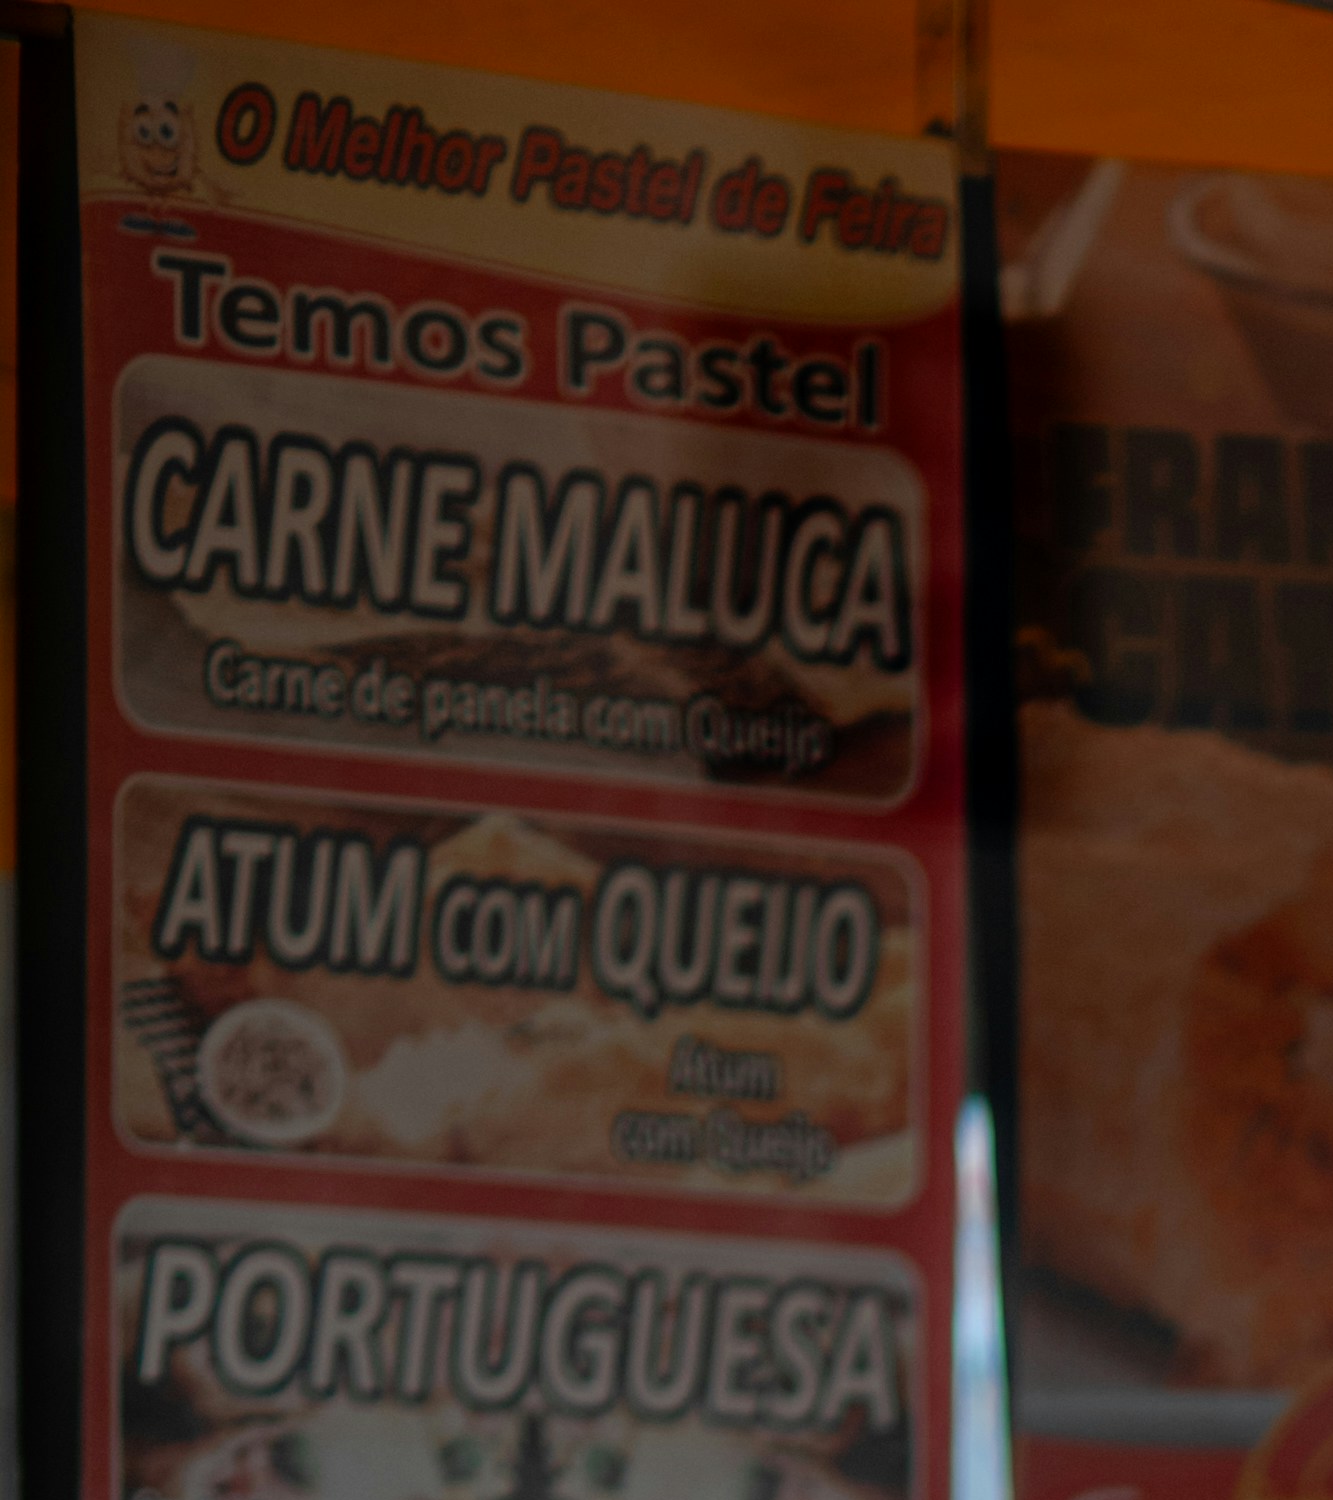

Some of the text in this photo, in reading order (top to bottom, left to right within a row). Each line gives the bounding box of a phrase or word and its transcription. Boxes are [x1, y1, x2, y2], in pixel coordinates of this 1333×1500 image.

[217, 82, 948, 260] O Melhor Pastel de Feira
[155, 252, 882, 428] Temos Pastel
[129, 418, 910, 670] CARNE MALUCA
[206, 640, 837, 777] Carne de panela com Queijo
[156, 815, 878, 1019] ATUM COM QUEIJO
[135, 1238, 902, 1432] PORTUGUESA
